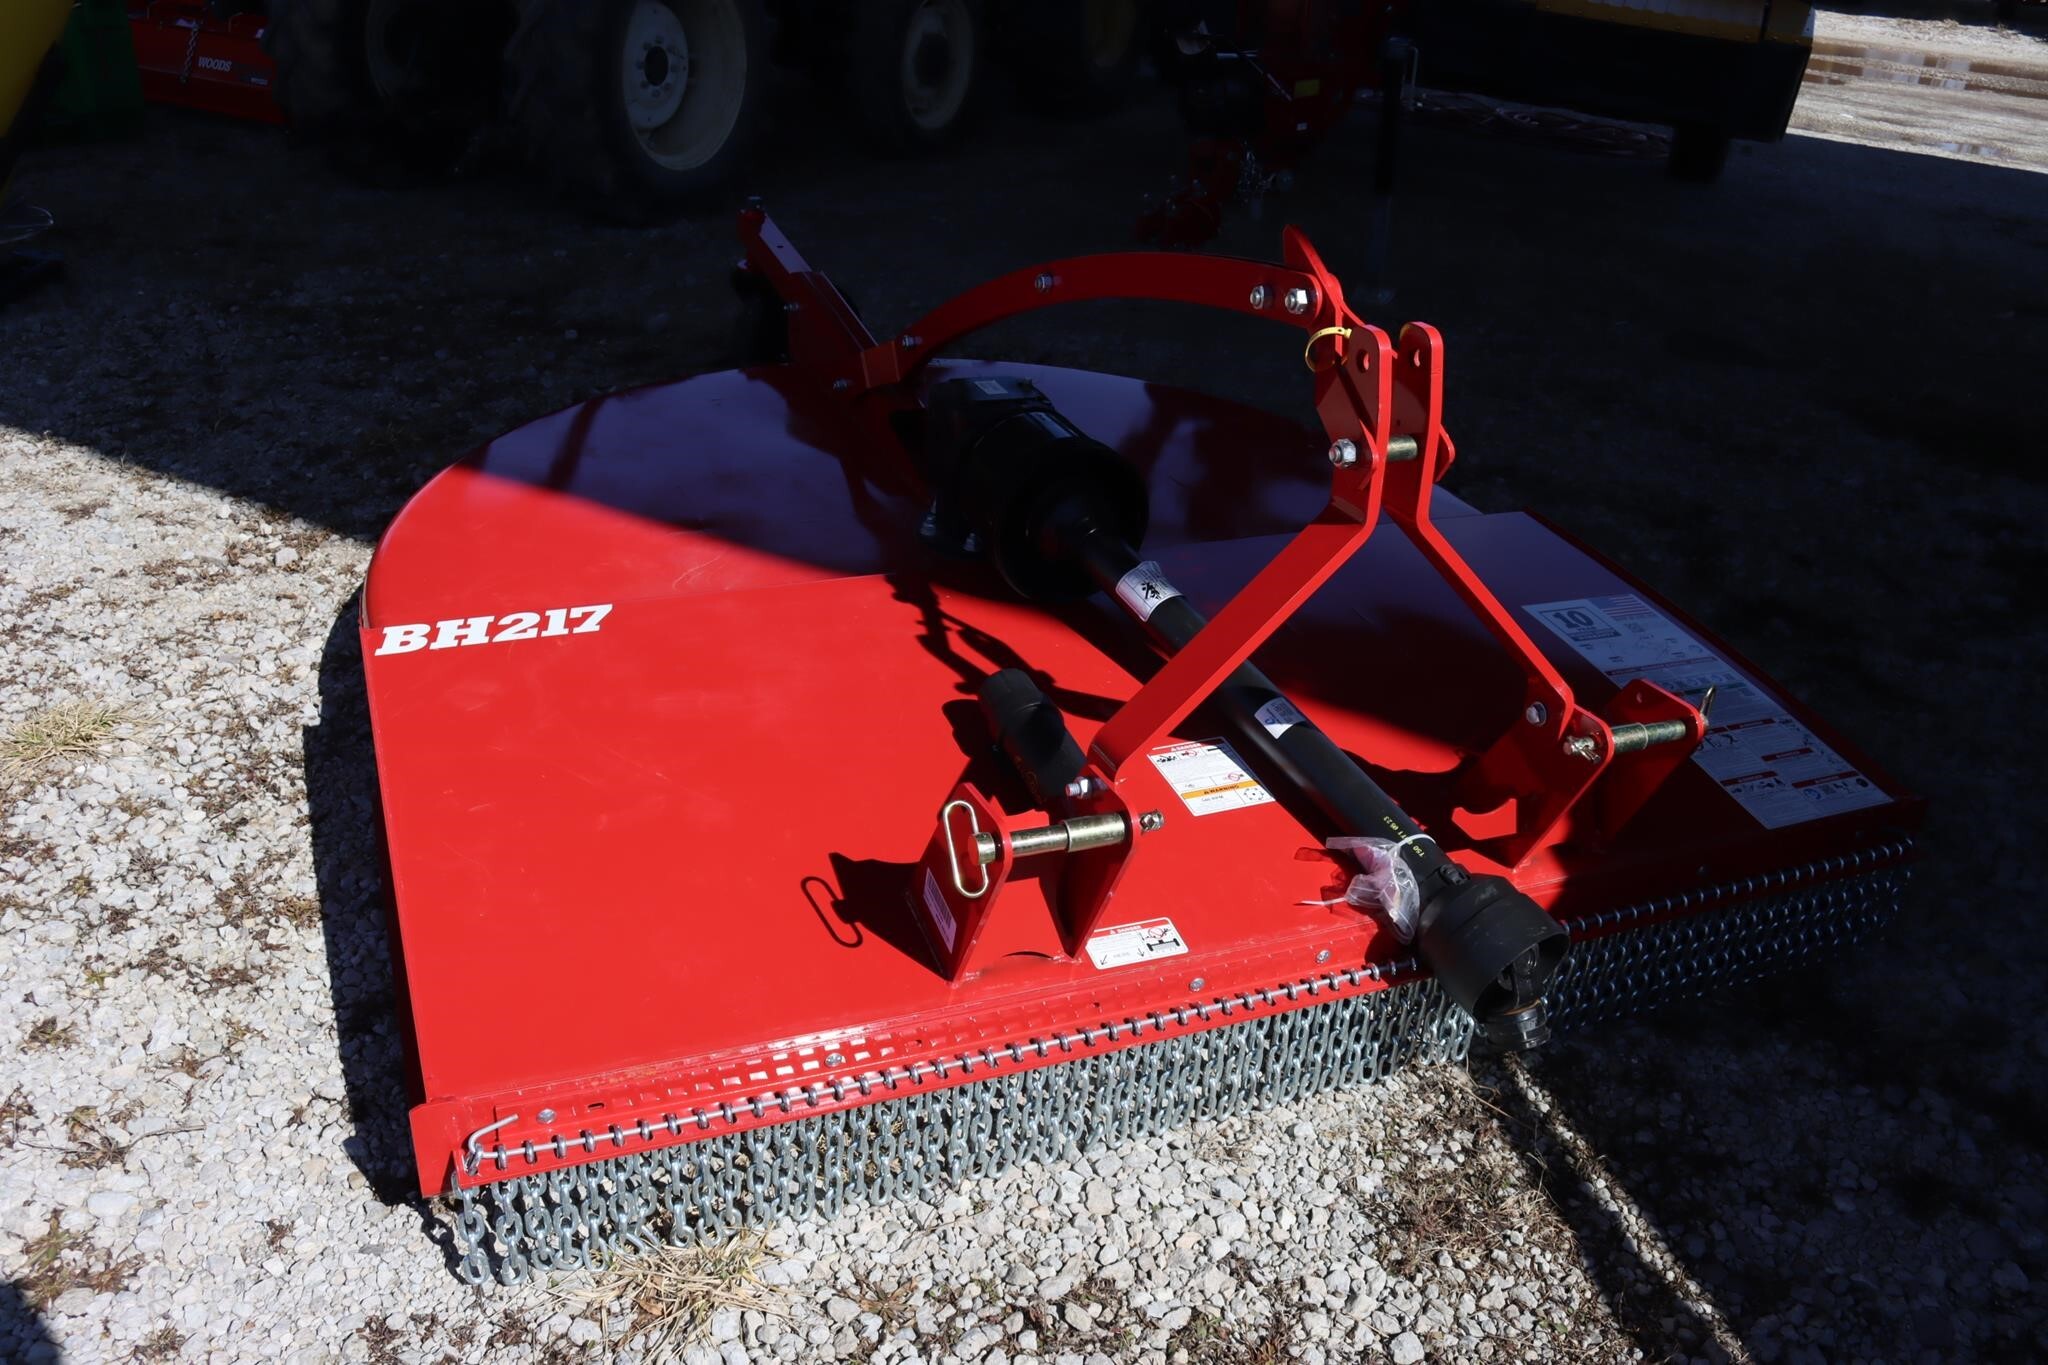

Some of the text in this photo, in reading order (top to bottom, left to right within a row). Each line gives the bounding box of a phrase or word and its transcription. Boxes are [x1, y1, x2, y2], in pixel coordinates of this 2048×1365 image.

[198, 56, 232, 72] WOODS
[1553, 611, 1594, 629] 10
[374, 603, 613, 656] BH217
